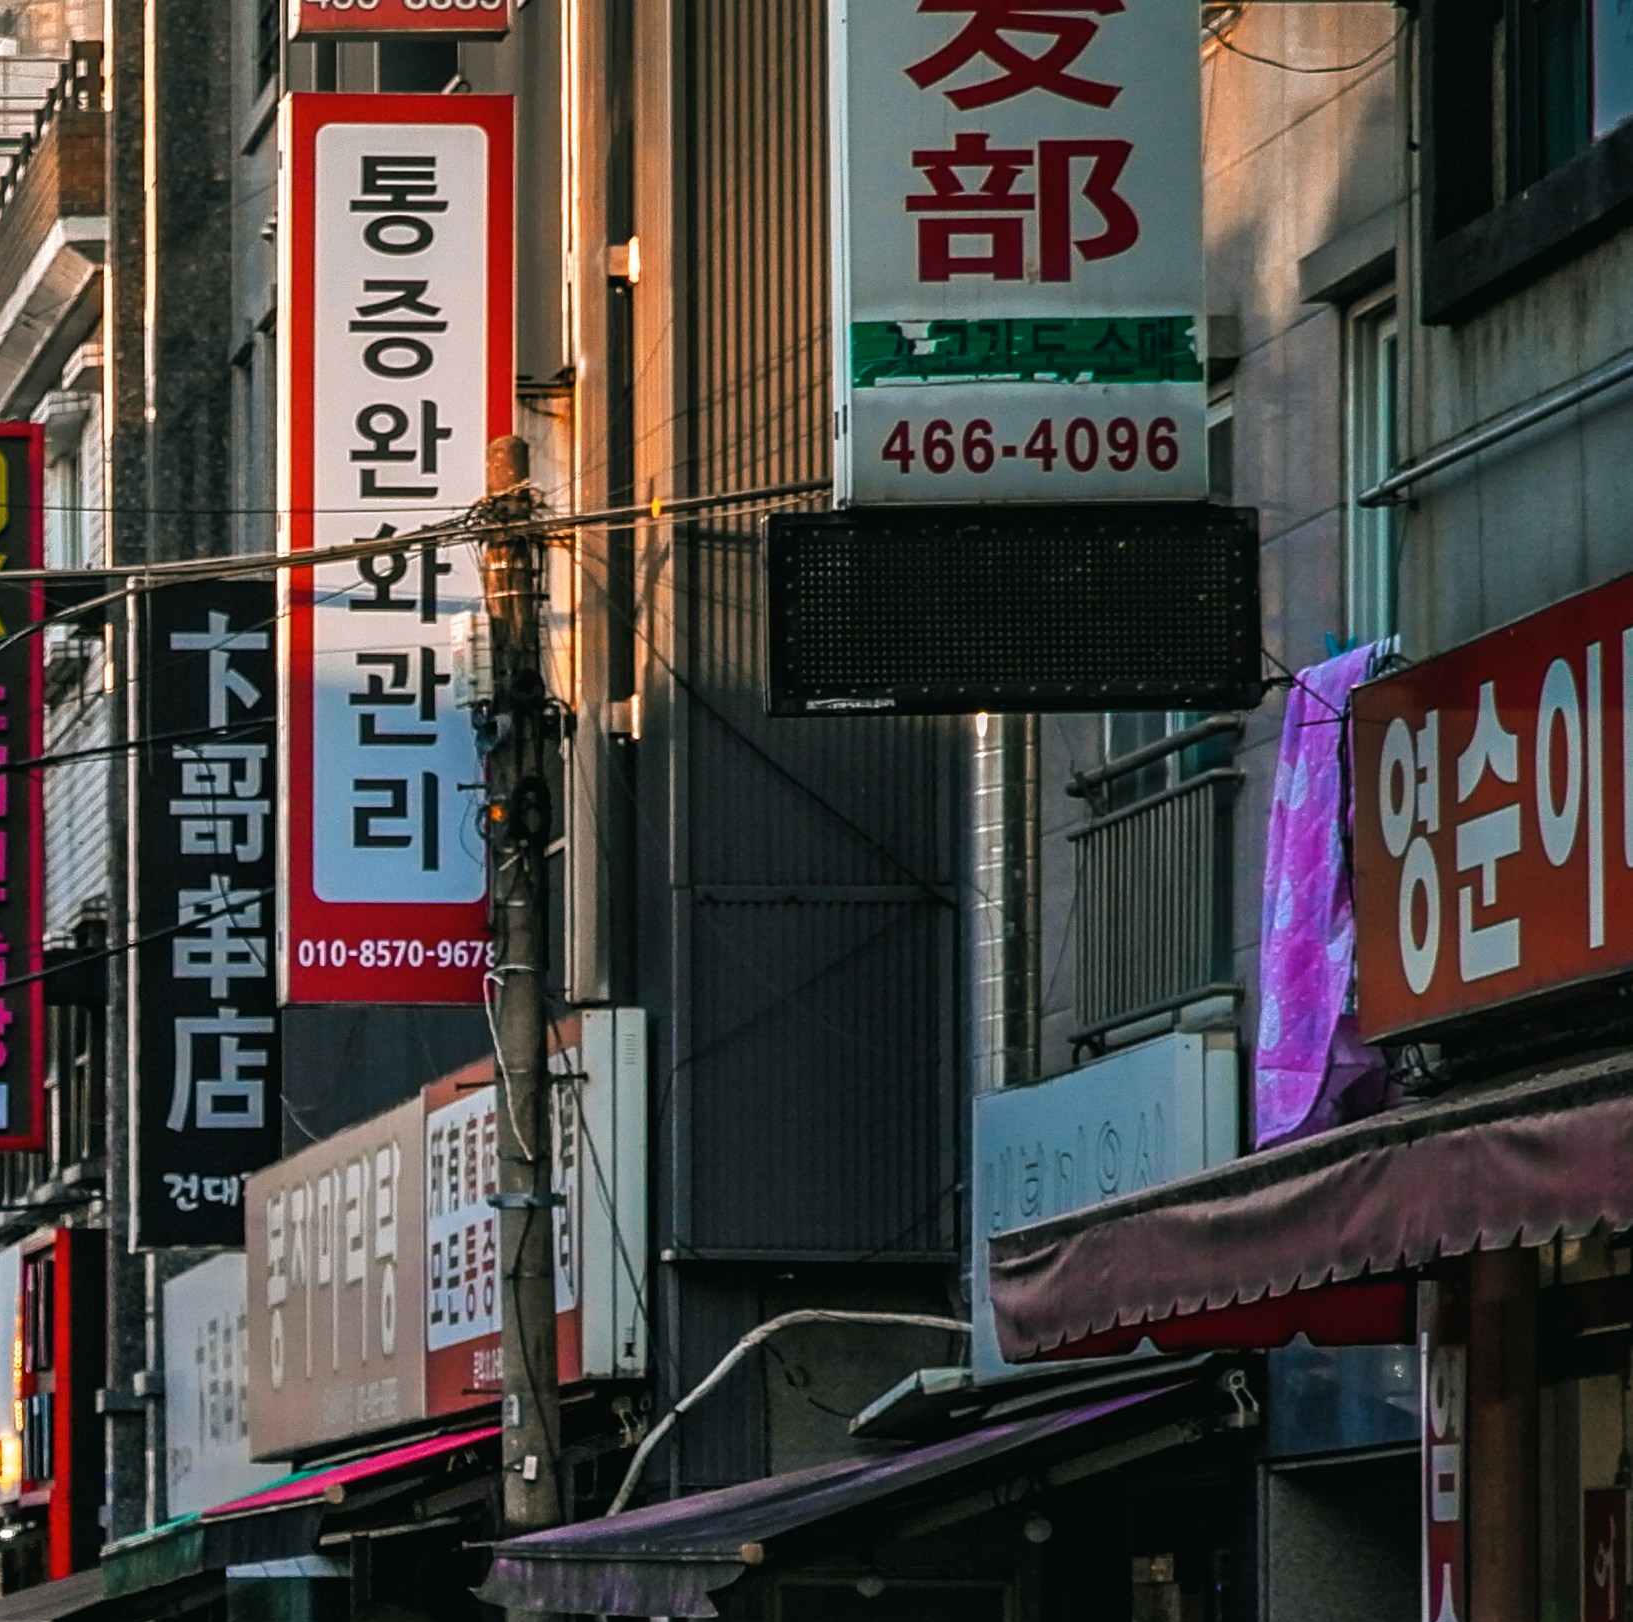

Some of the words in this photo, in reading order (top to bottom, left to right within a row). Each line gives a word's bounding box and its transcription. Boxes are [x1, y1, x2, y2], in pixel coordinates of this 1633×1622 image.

[348, 154, 452, 873] 통증완화관리
[881, 416, 1180, 474] 466-4096
[166, 611, 275, 1132] 卞哥串店
[1379, 629, 1633, 995] 영순이
[163, 1172, 250, 1212] 건대
